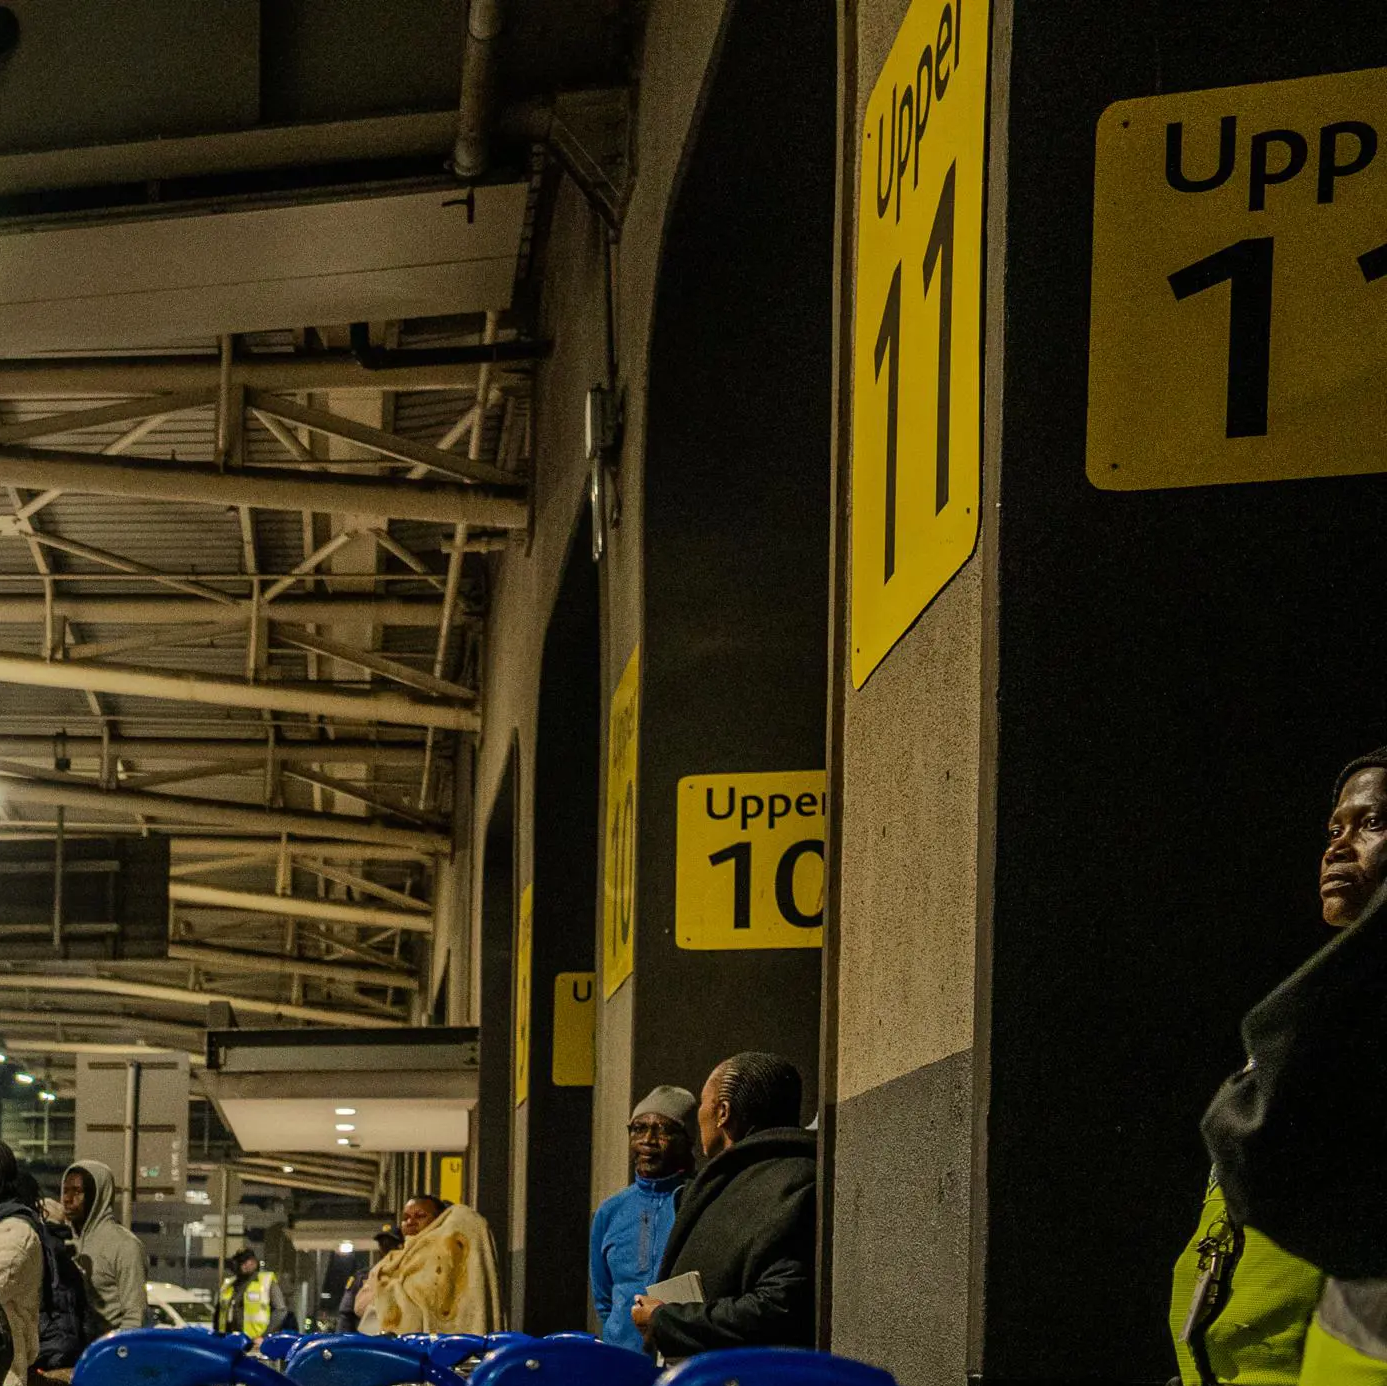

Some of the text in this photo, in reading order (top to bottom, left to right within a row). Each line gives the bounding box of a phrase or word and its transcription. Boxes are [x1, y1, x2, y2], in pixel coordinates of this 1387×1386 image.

[875, 157, 957, 587] 11
[1166, 236, 1387, 440] 1
[707, 839, 825, 929] 10
